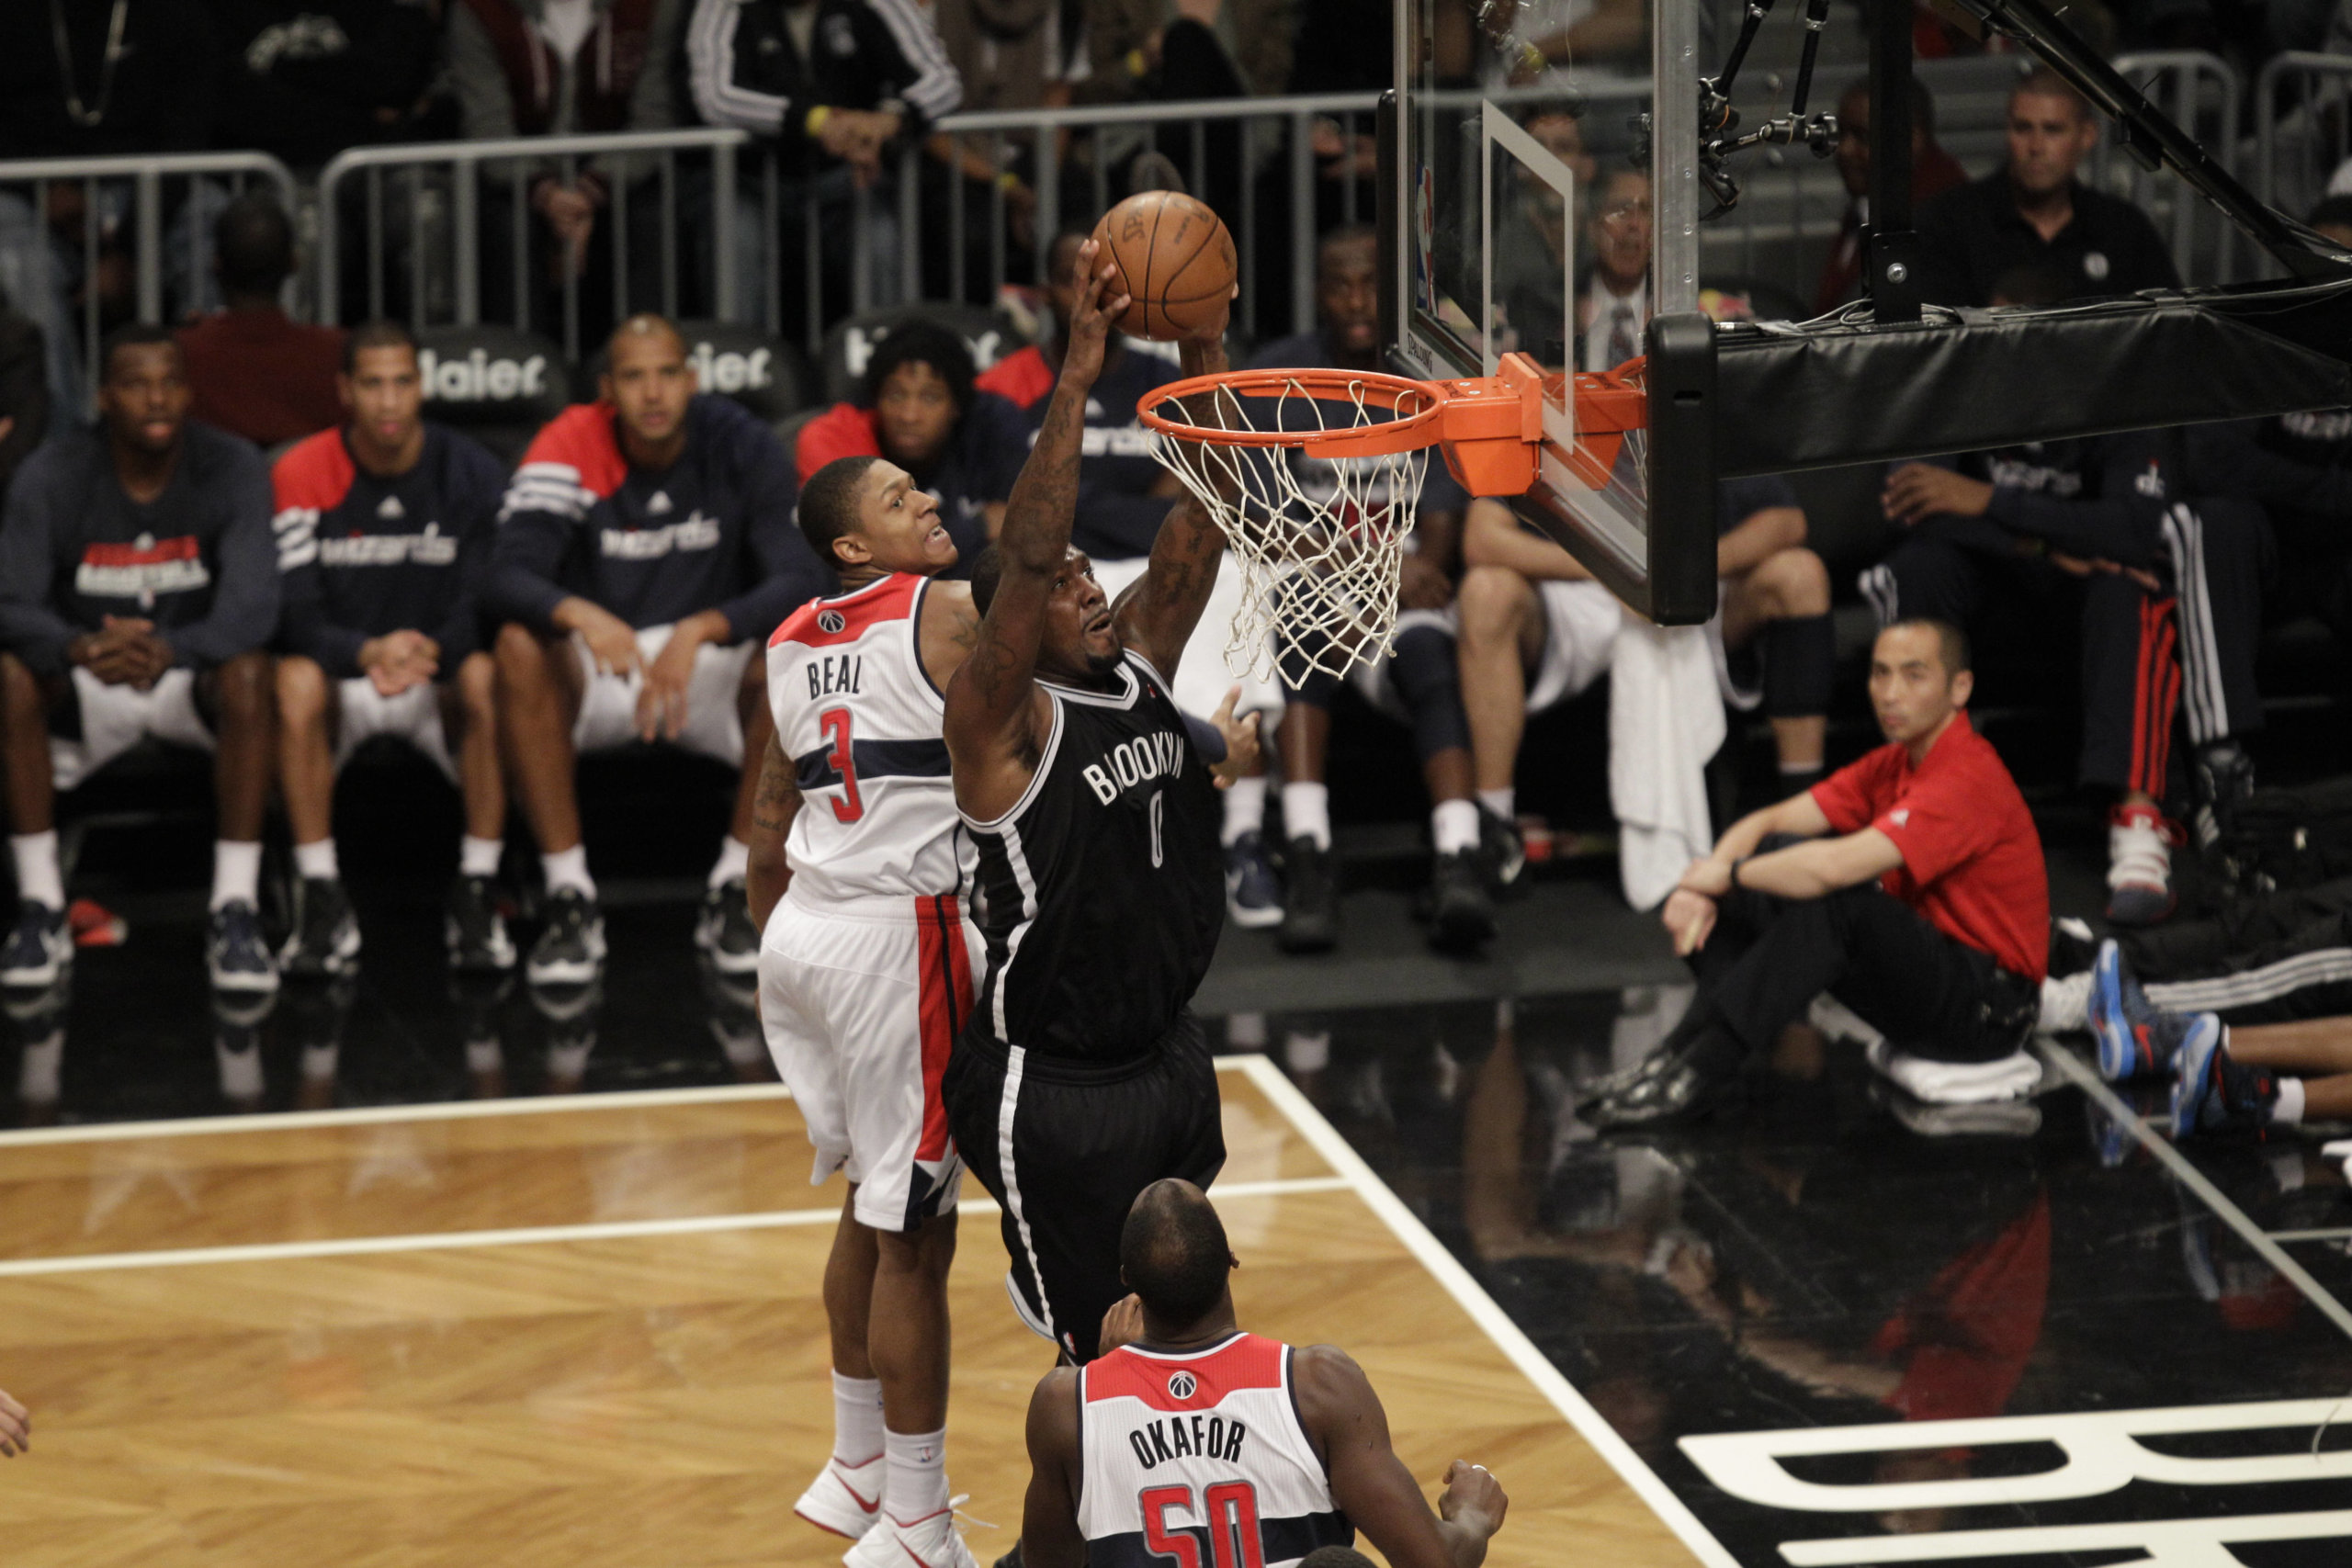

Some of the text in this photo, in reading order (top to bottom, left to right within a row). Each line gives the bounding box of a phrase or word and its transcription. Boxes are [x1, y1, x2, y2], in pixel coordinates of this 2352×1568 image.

[1408, 332, 1433, 374] SPALDING
[807, 654, 862, 700] BEAL
[820, 705, 865, 825] 3
[1082, 731, 1184, 806] BOOKYN
[1129, 1416, 1246, 1470] OKAFOR
[1137, 1480, 1267, 1568] 50
